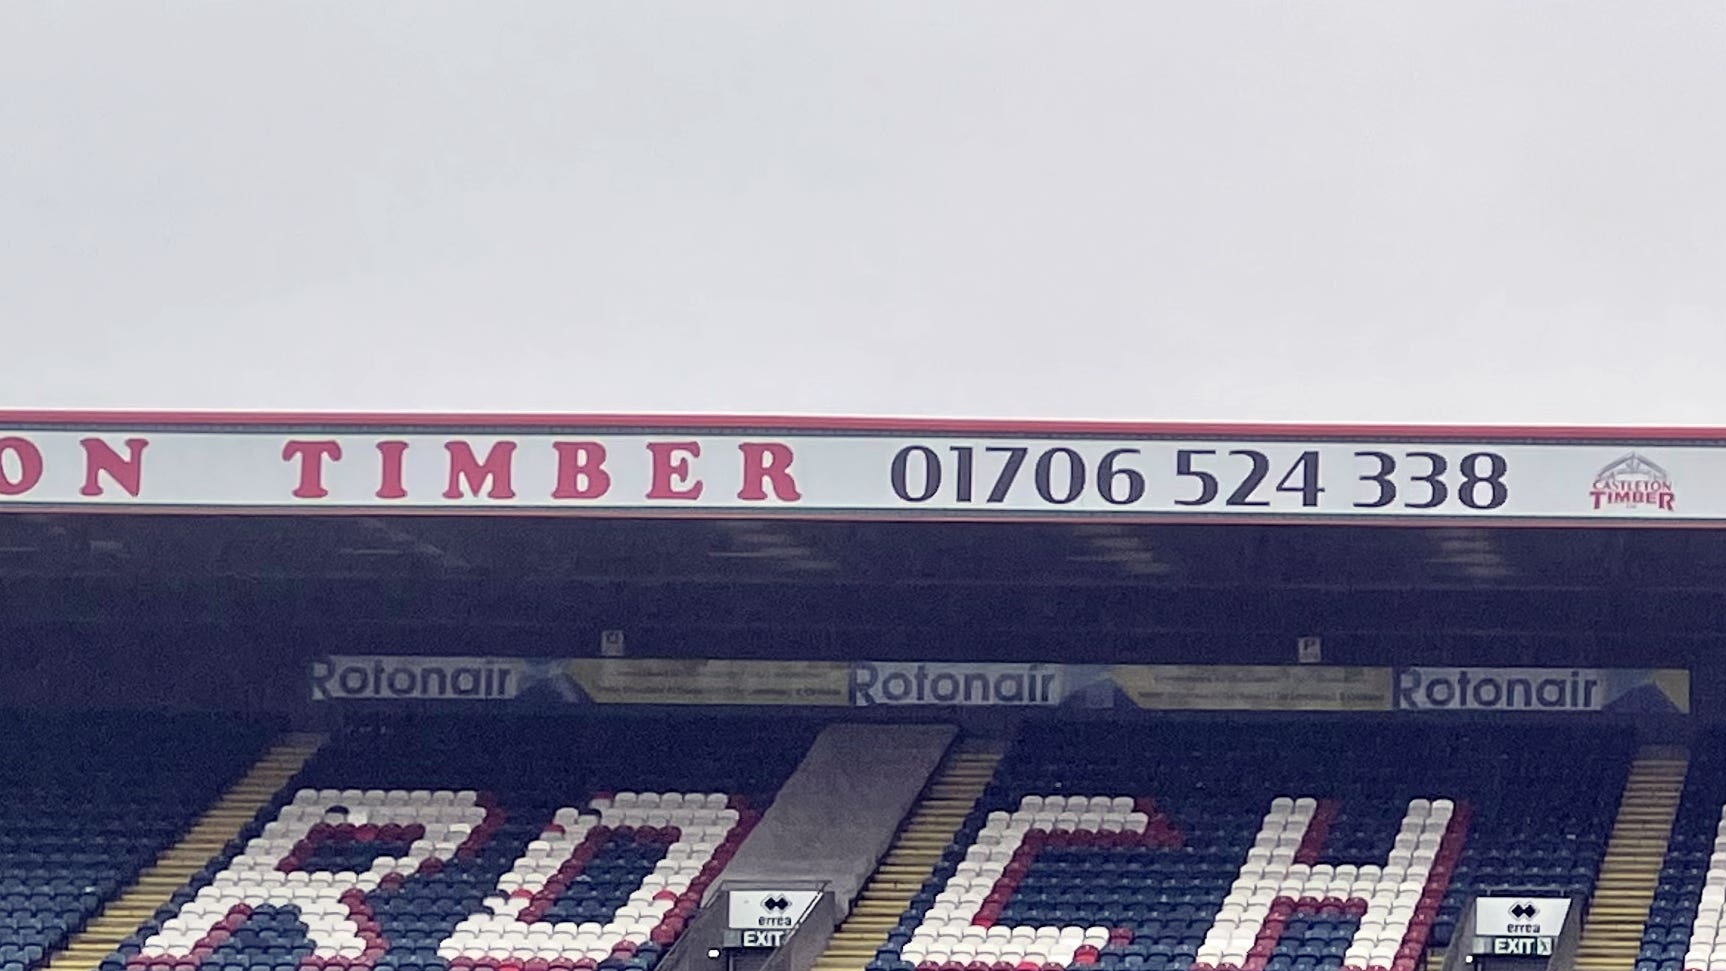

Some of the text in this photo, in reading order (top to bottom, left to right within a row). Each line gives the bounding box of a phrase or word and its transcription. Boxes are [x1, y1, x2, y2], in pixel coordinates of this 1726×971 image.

[0, 436, 1510, 511] ON TIMBER 01706 524 338
[1593, 479, 1672, 491] CASTLETON
[1590, 491, 1675, 511] TIMBER
[311, 656, 511, 699] Rotonair
[849, 661, 1056, 704] Rotonair
[1393, 664, 1598, 709] Rotonair
[743, 930, 784, 947] EXIT
[1494, 938, 1536, 954] EXIT
